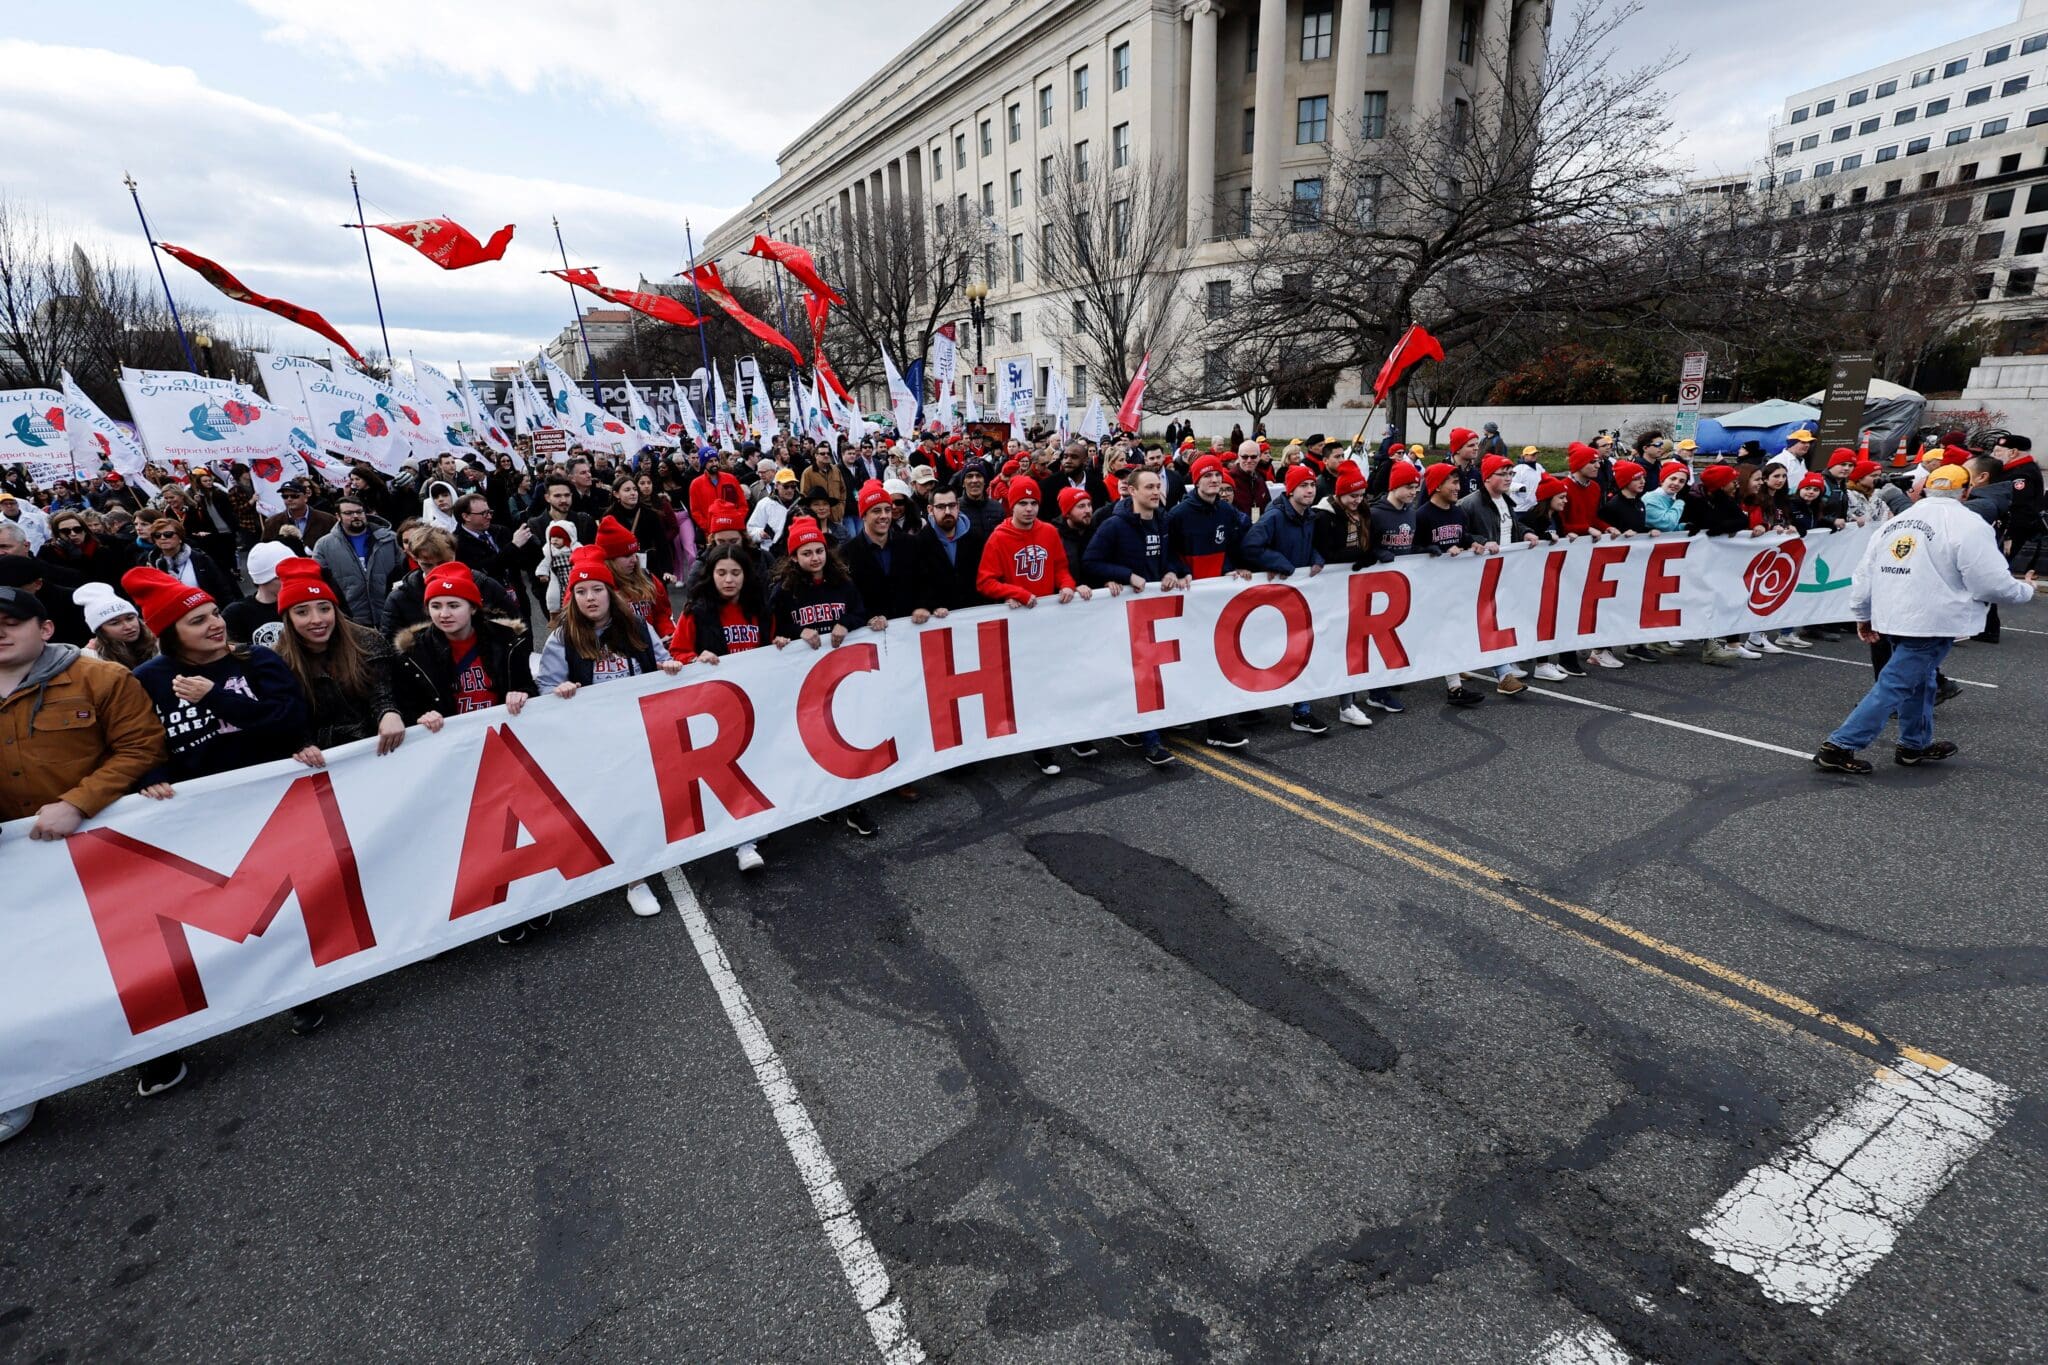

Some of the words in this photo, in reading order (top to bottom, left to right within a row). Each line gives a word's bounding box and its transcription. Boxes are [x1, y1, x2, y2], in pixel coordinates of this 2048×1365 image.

[66, 620, 1016, 1035] MARCH
[1126, 570, 1411, 714] FOR
[1477, 541, 1691, 652] LIFE
